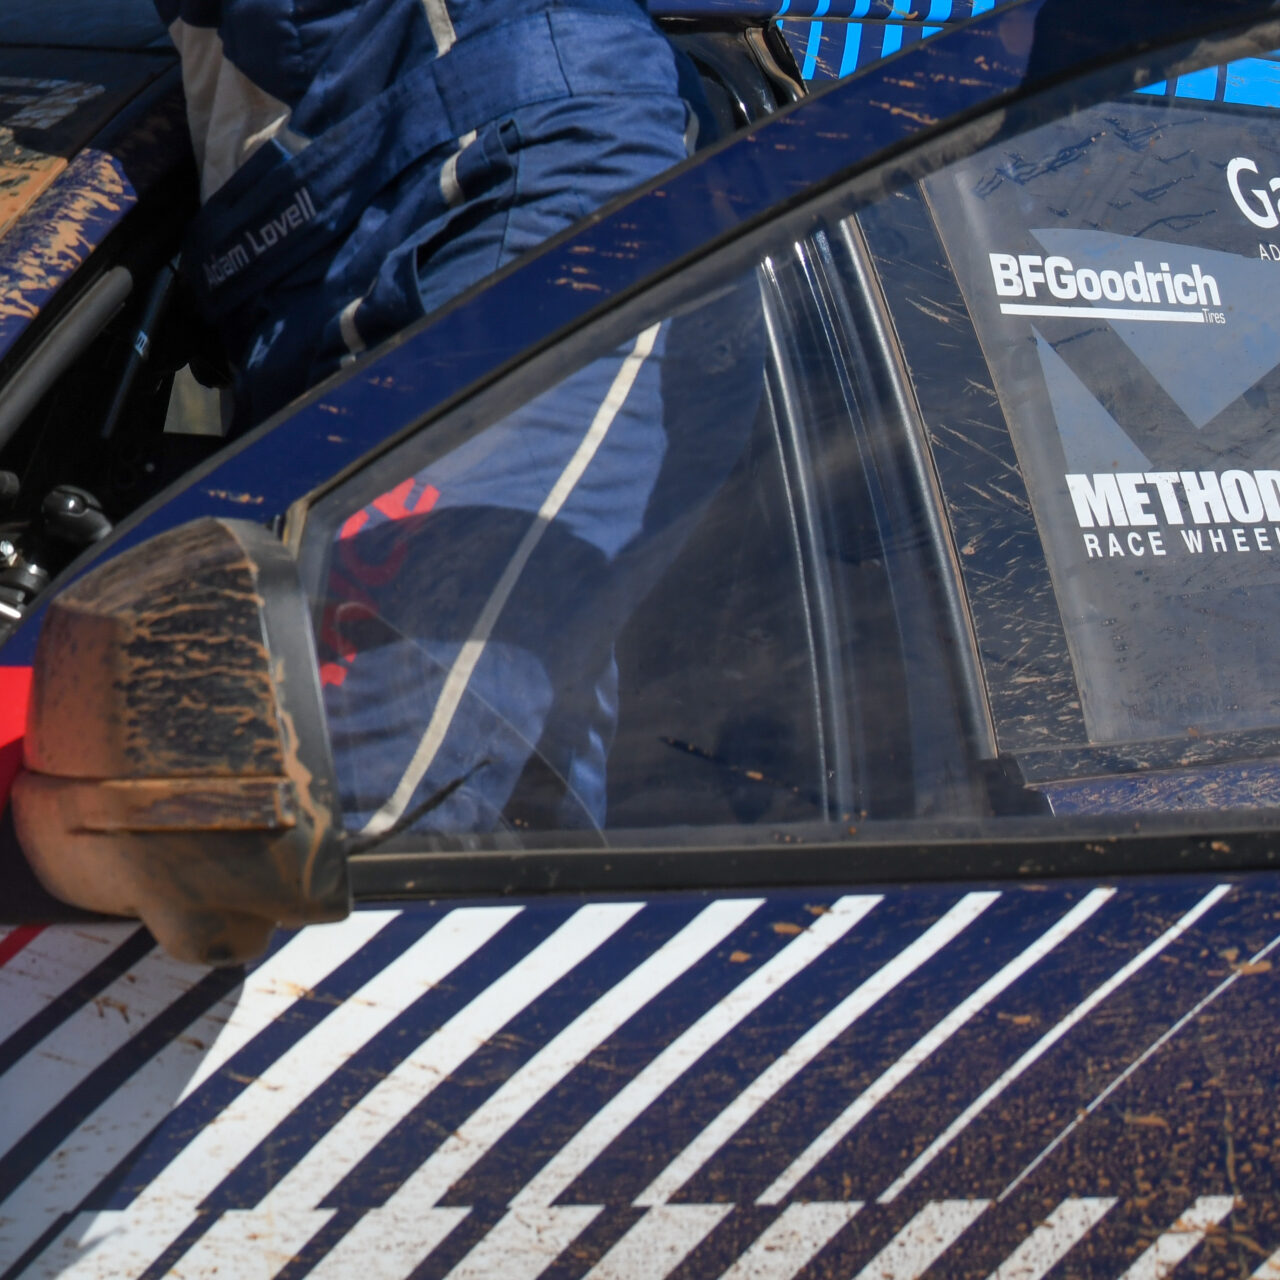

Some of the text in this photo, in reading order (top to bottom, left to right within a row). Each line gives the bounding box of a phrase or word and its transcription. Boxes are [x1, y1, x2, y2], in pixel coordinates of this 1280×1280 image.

[244, 186, 317, 256] Lovell
[989, 253, 1222, 306] BFGoodrich
[1202, 308, 1227, 324] Tires
[1083, 527, 1280, 558] RACE WHEE
